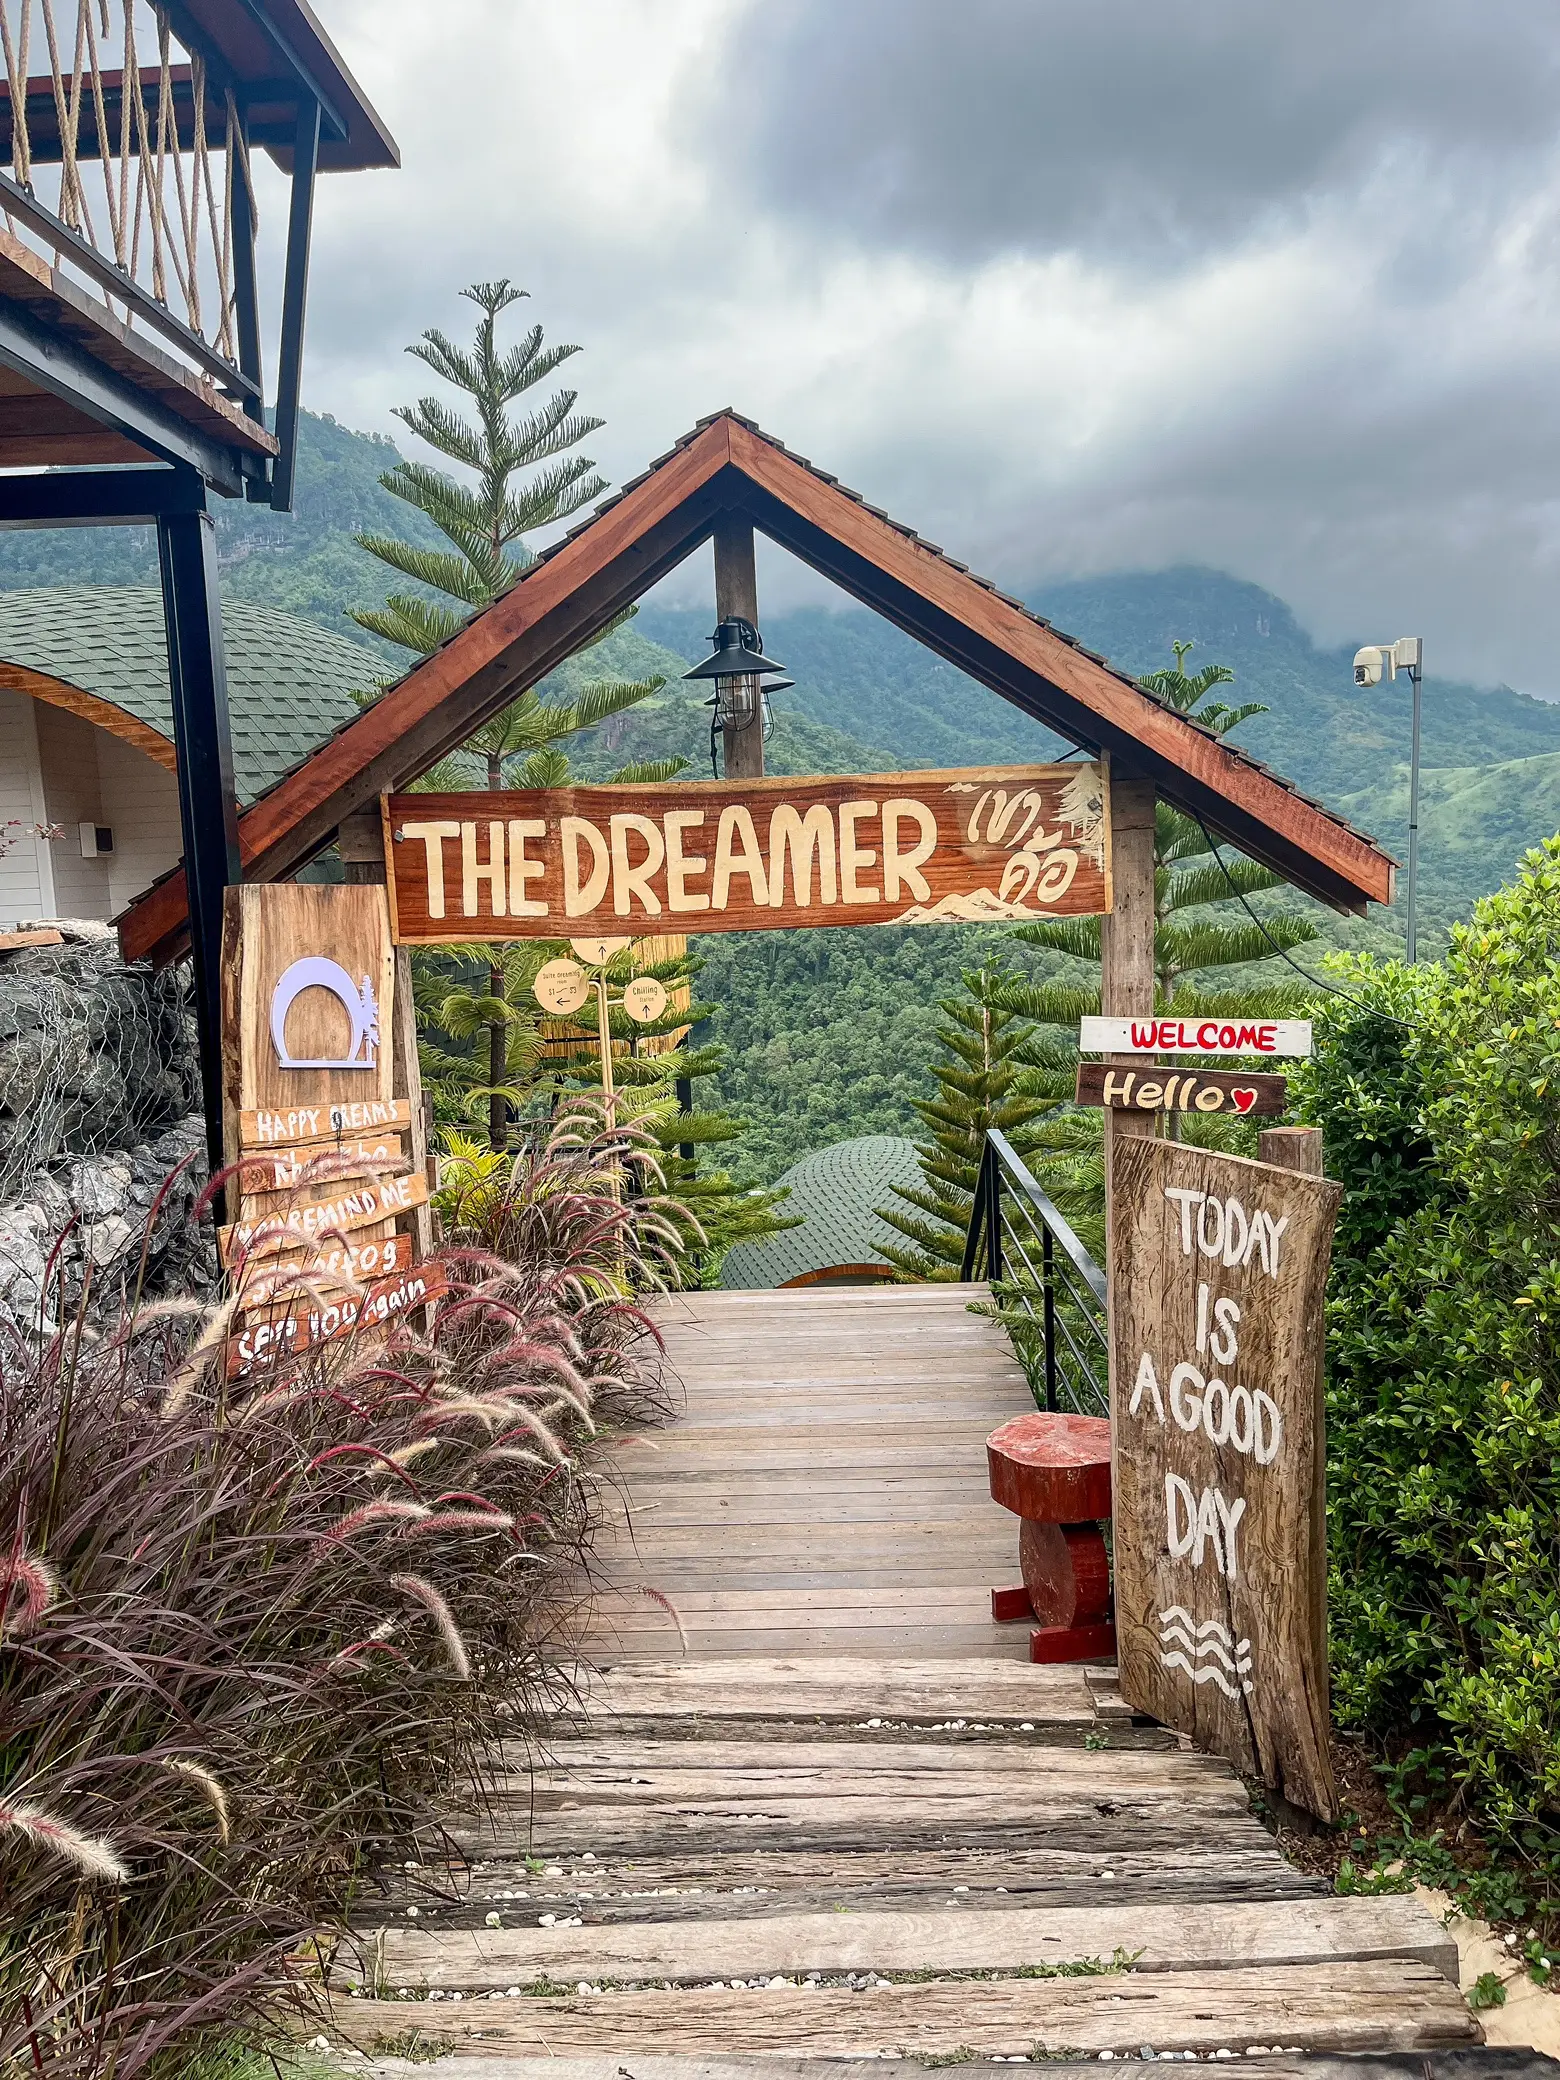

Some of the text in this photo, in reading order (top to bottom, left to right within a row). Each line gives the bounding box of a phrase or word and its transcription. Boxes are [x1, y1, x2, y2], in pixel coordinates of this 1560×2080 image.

[401, 798, 938, 919] THE DREAMER
[632, 985, 658, 996] Chilling
[1130, 1022, 1278, 1050] WELCOME
[1102, 1071, 1224, 1111] Hello
[256, 1110, 321, 1144] HAPPY
[287, 1190, 377, 1236] REMIND
[379, 1178, 412, 1210] ME
[1164, 1187, 1289, 1280] TODAY
[1195, 1283, 1241, 1366] IS
[1129, 1351, 1282, 1465] A GOOD
[1165, 1472, 1246, 1580] DAY
